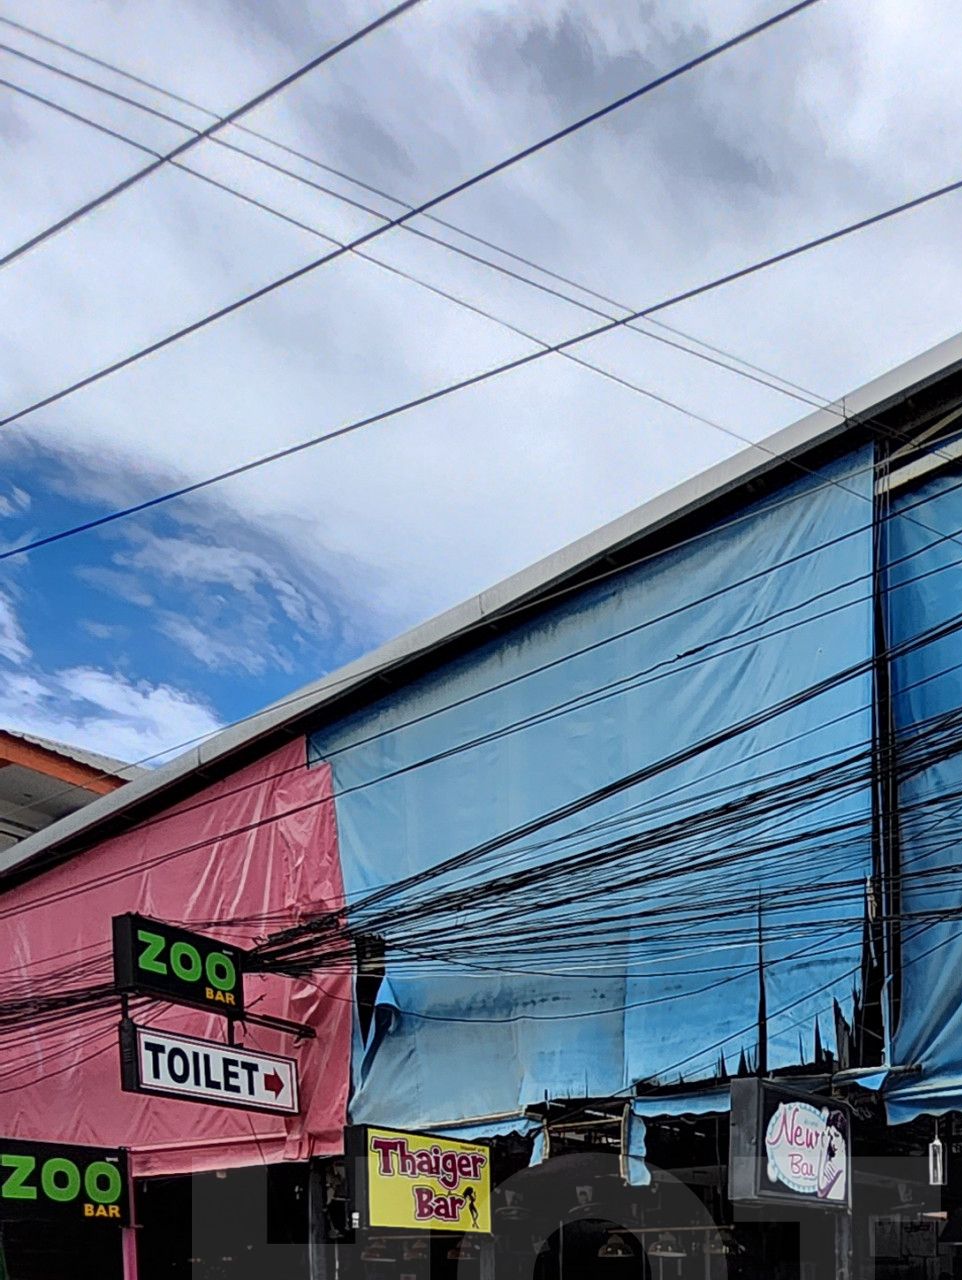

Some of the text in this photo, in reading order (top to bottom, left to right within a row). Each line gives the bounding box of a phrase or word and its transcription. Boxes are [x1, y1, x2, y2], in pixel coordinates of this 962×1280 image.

[137, 929, 236, 991] ZOO
[205, 987, 236, 1005] BAR
[144, 1041, 259, 1096] TOILET
[767, 1106, 820, 1150] New
[0, 1154, 122, 1204] ZOO
[371, 1136, 487, 1191] Thaiger
[84, 1203, 121, 1218] BAR
[413, 1185, 467, 1222] Bar
